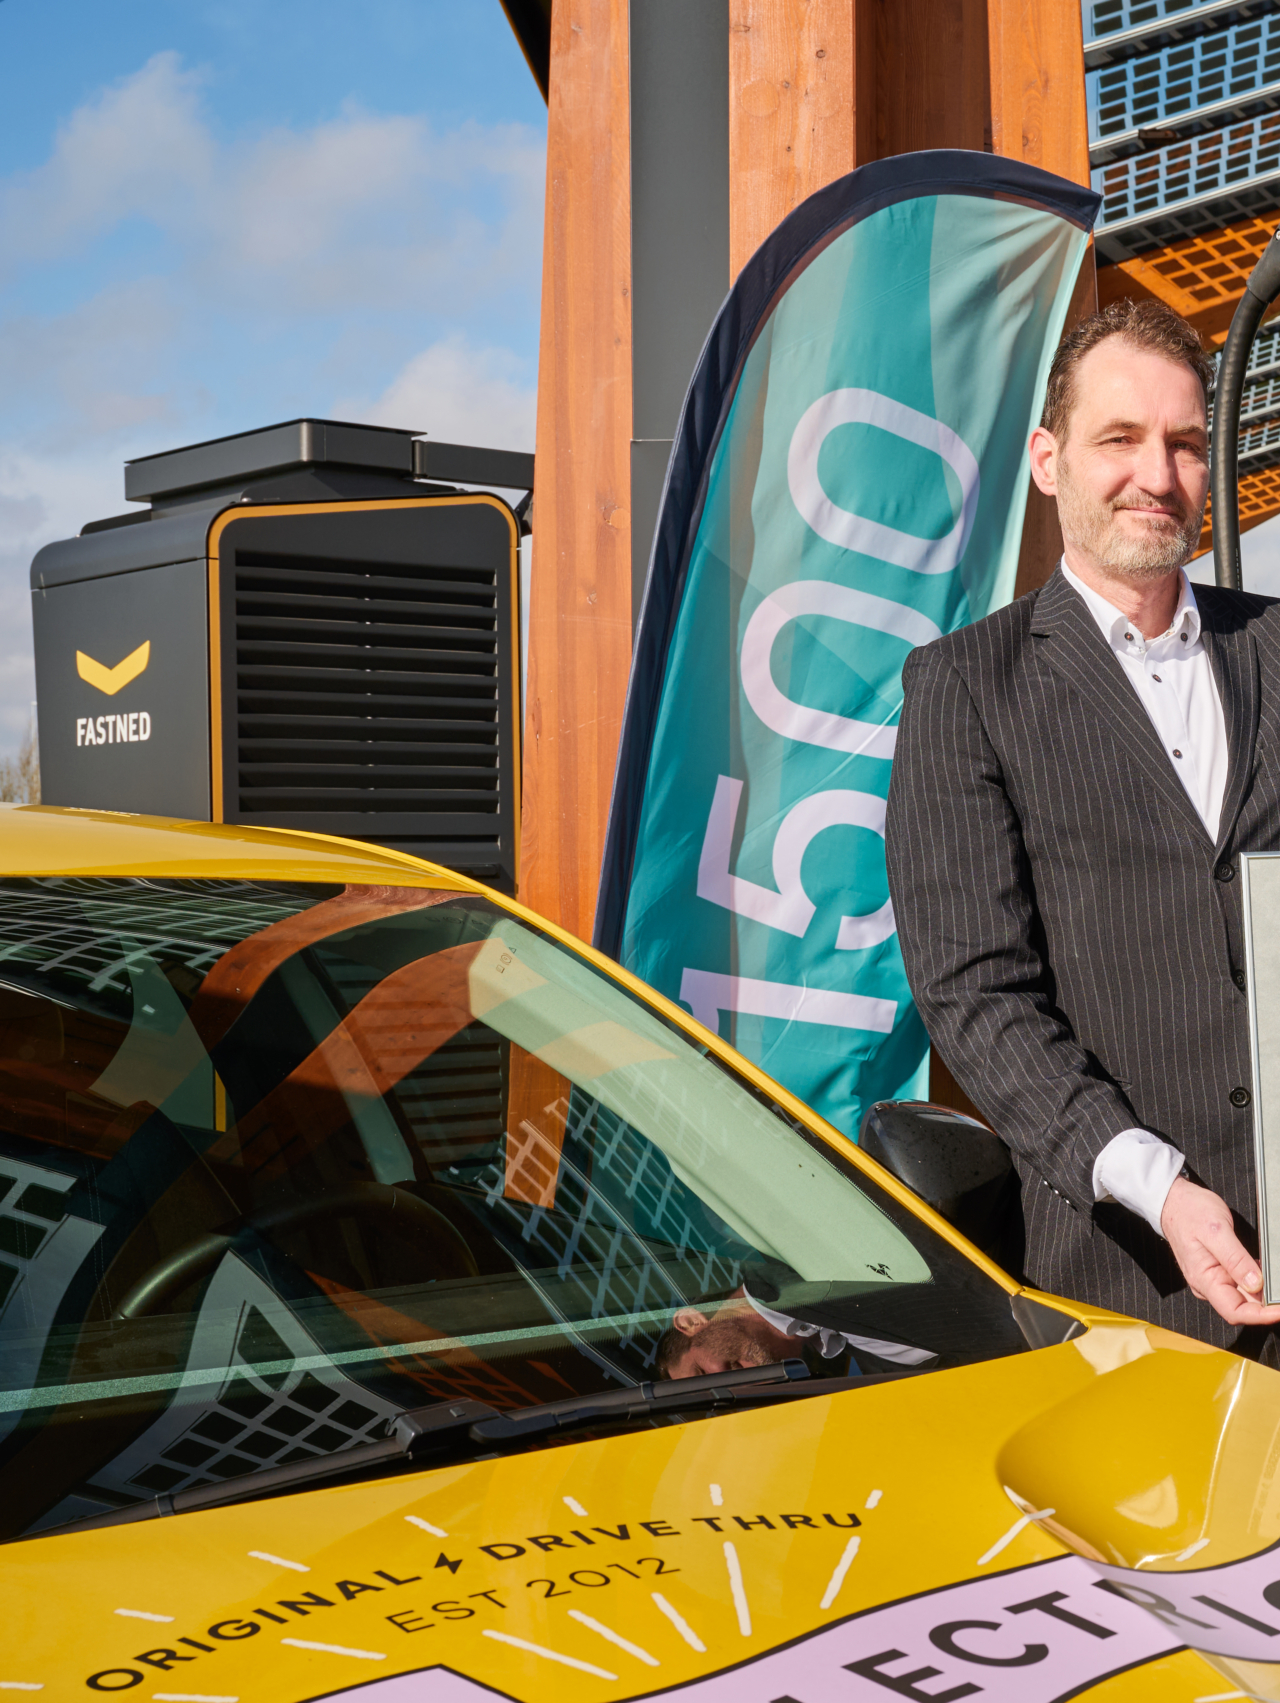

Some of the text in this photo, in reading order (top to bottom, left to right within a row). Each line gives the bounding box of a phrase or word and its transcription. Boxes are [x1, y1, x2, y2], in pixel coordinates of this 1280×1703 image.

[76, 711, 151, 747] FASTNED
[679, 387, 980, 1051] 1500
[86, 1513, 863, 1692] ORIGINAL DRIVE THRU
[385, 1557, 682, 1633] EST 2012
